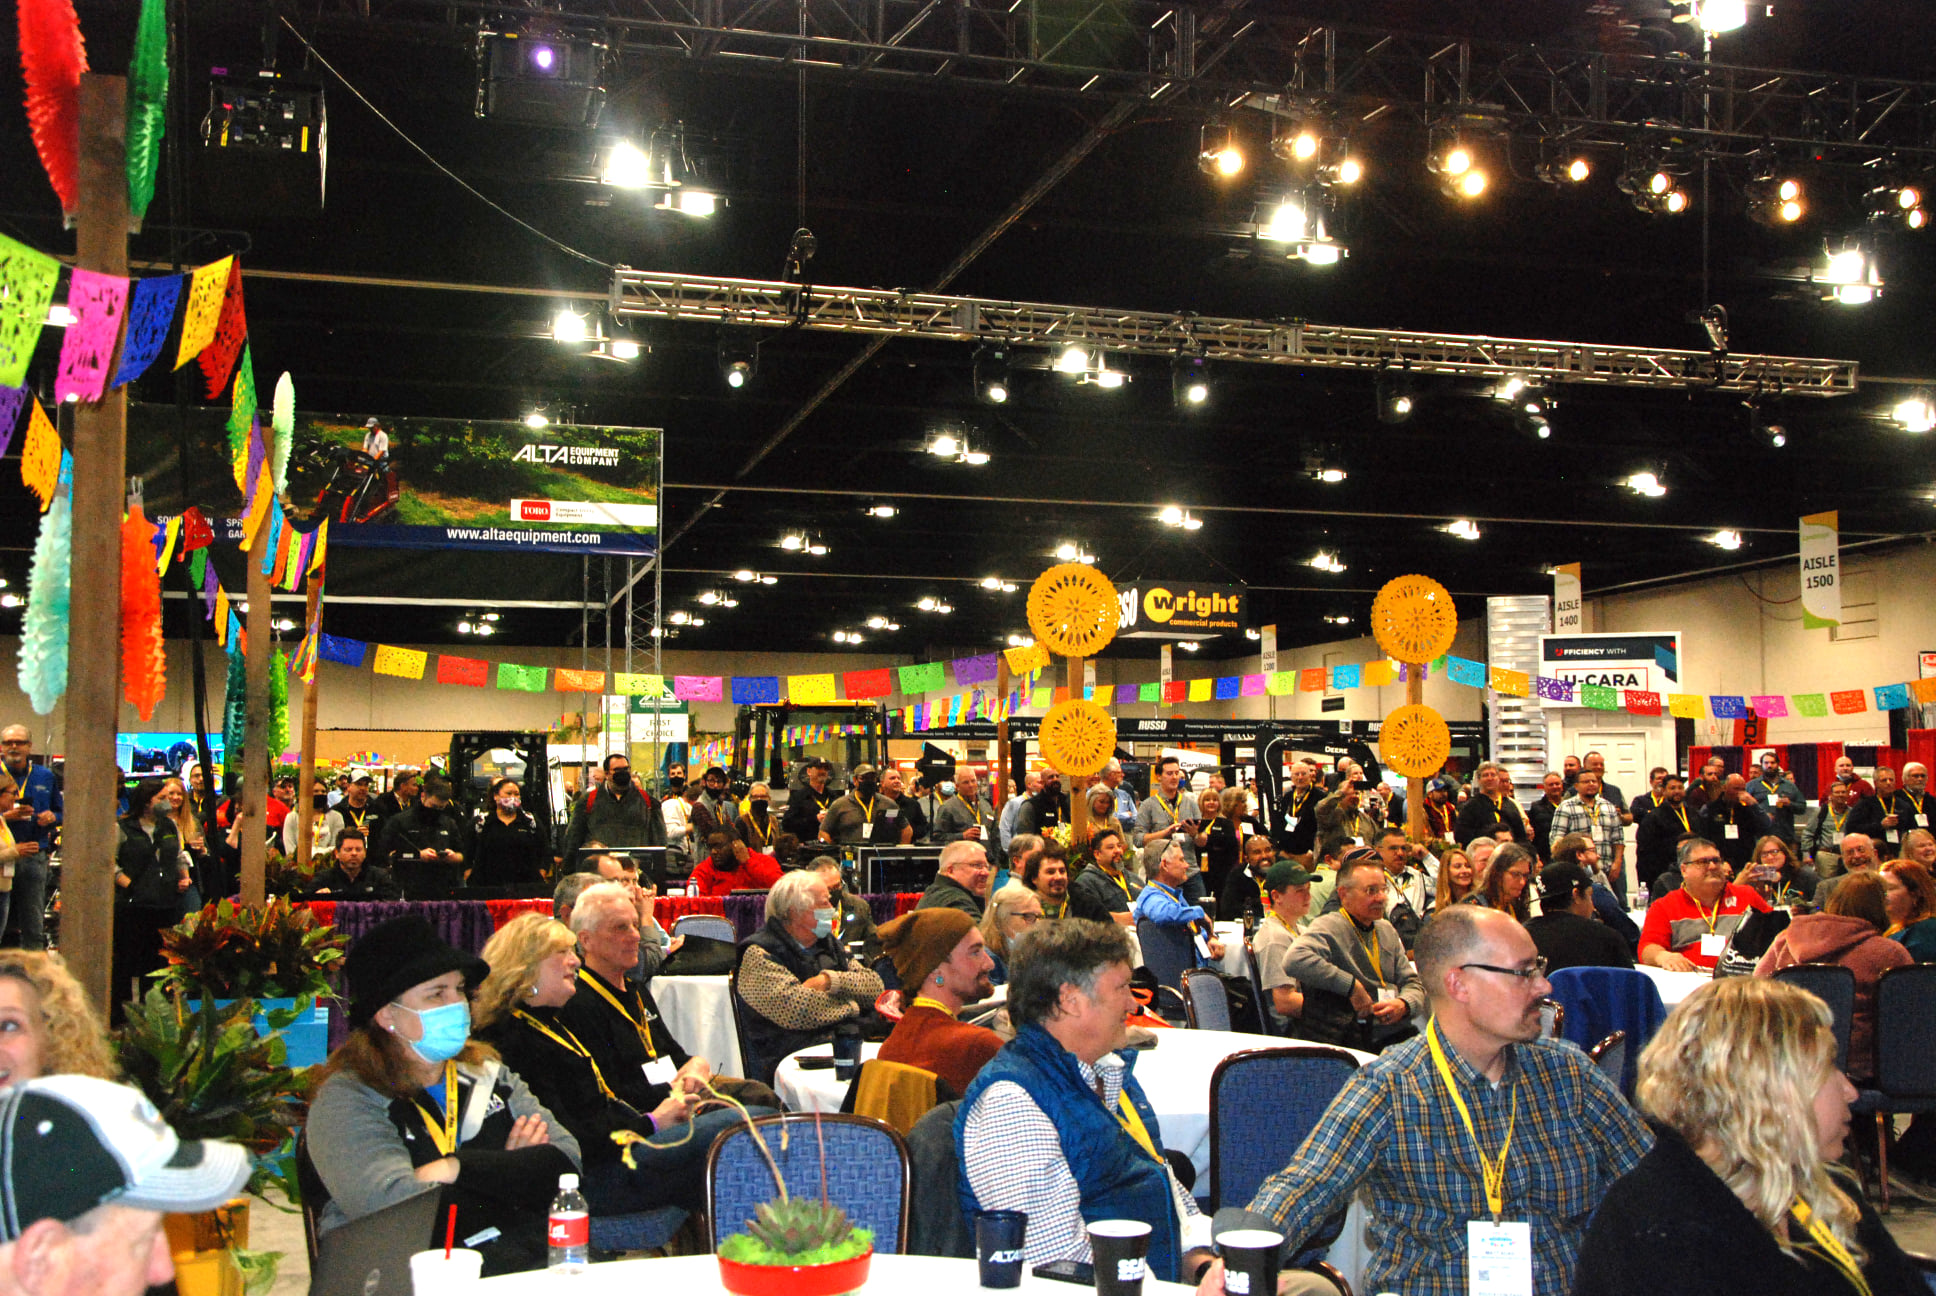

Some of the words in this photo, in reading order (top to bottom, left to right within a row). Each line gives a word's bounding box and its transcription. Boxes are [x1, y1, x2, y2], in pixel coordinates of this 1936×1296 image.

[512, 444, 569, 464] ALTA
[570, 446, 619, 457] EQUIPMENT
[570, 456, 619, 467] COMPANY
[522, 505, 549, 516] TORO
[447, 528, 601, 544] www.altaequipment.com
[1803, 555, 1835, 571] AISLE
[1806, 575, 1834, 589] 1500
[1557, 599, 1579, 612] AISLE
[1169, 619, 1208, 627] commercial
[1560, 615, 1578, 627] 1400
[1138, 720, 1168, 731] RUSSO
[1325, 745, 1349, 754] DEERE
[1117, 1257, 1145, 1275] SCA
